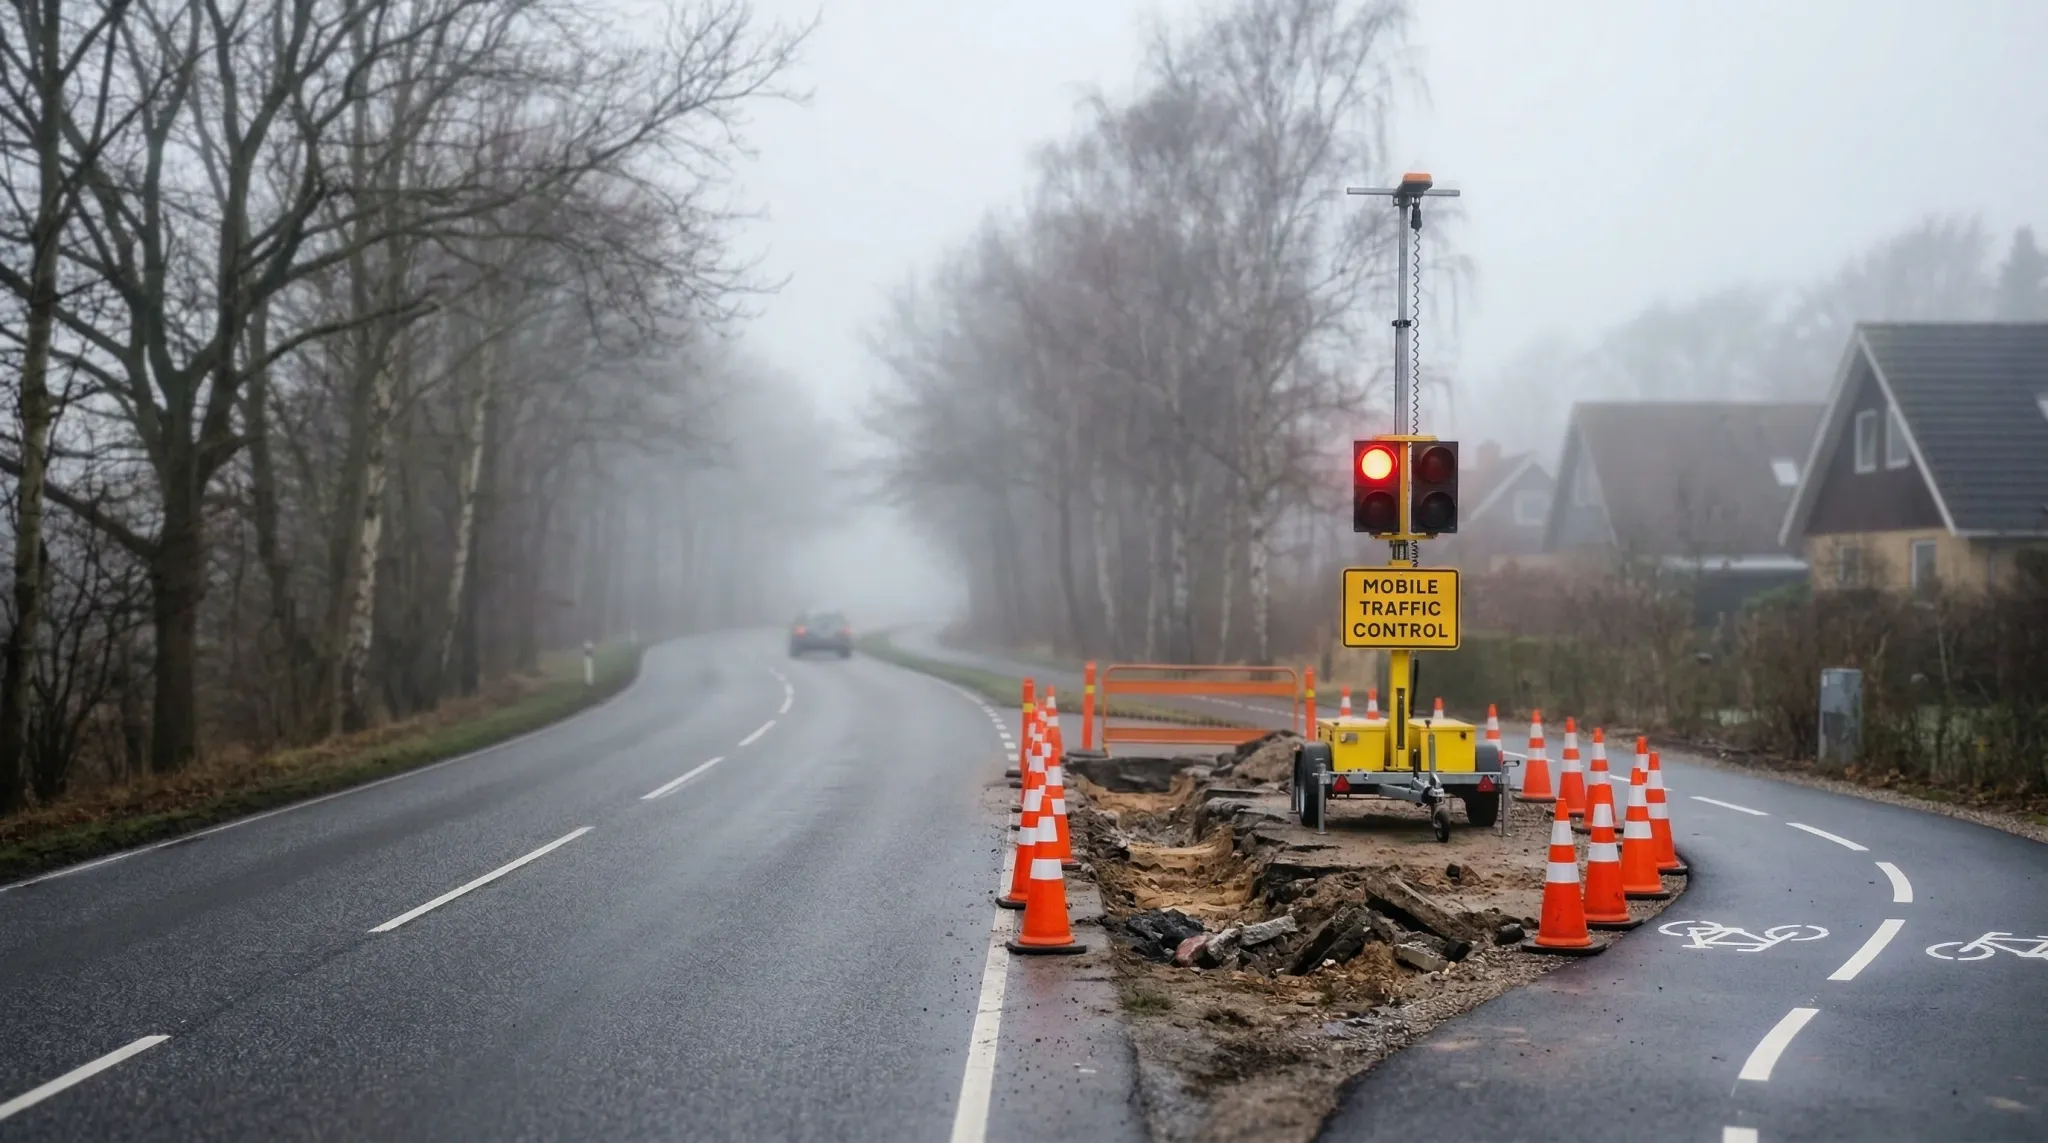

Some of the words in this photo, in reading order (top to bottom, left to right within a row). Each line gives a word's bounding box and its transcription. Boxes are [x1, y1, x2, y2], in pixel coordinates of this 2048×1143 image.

[1363, 579, 1438, 594] MOBILE
[1359, 601, 1441, 616] TRAFFIC
[1353, 622, 1448, 638] CONTROL
